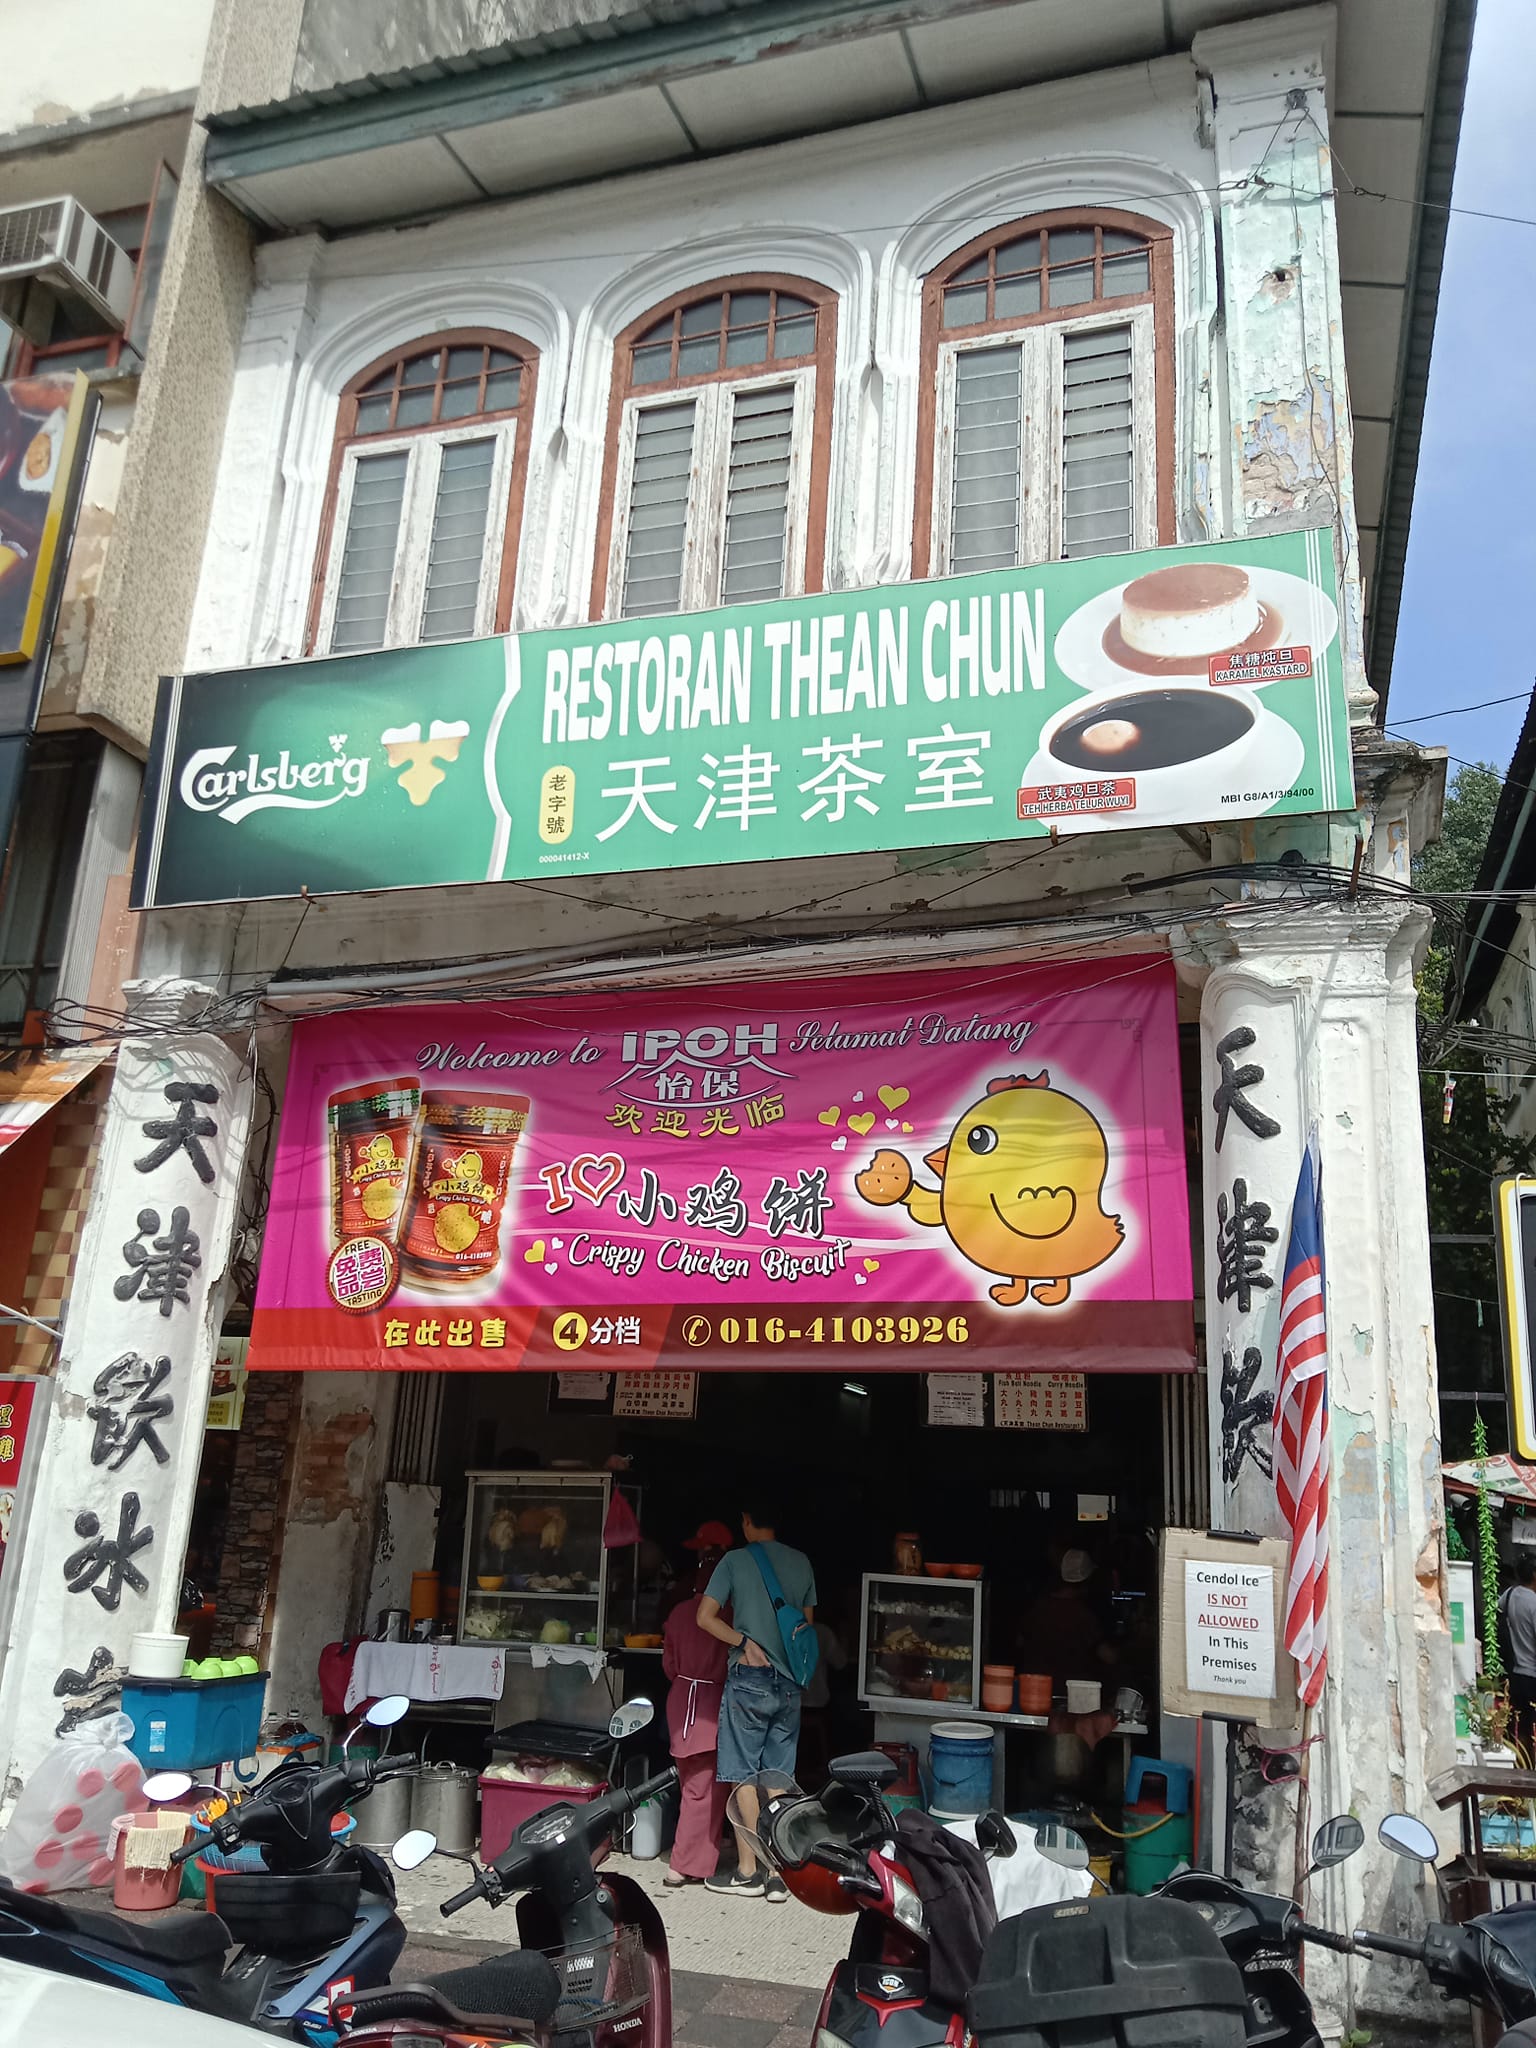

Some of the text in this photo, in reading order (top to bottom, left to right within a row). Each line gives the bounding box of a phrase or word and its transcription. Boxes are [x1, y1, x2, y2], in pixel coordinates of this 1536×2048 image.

[542, 588, 1045, 743] RESTORAN THEAN CHUN
[1229, 649, 1294, 669] 焦糖炖旦
[1216, 663, 1306, 681] KARAMEL KASTARD
[180, 745, 371, 825] Carlsberg
[595, 723, 994, 843] 天津茶室
[1038, 781, 1116, 801] 武夷鸡旦茶
[546, 774, 567, 834] 老字號
[1024, 795, 1130, 814] TEH HERBA TELUR WUYI
[1221, 787, 1314, 804] MBI G8/A1/3/94/00
[620, 1022, 779, 1063] IPOH
[789, 1012, 1041, 1054] Selamat Datang
[415, 1036, 606, 1071] Welcome to
[655, 1070, 740, 1101] 怡保
[605, 1093, 787, 1139] 欢迎光临
[616, 1166, 835, 1239] 小鸡饼
[344, 1240, 370, 1255] FREE
[568, 1233, 853, 1282] Crispy Chicken Biscuit
[346, 1289, 383, 1306] TASTING
[383, 1317, 507, 1347] 在此出售
[720, 1316, 969, 1343] 016-4103926
[1196, 1571, 1259, 1587] Cendol Ice
[1207, 1593, 1248, 1607] IS NOT
[1198, 1613, 1259, 1629] ALLOWED
[1209, 1636, 1248, 1650] In This
[1202, 1655, 1257, 1672] Premises
[1214, 1675, 1247, 1686] Thank you
[613, 2017, 642, 2033] HONDA
